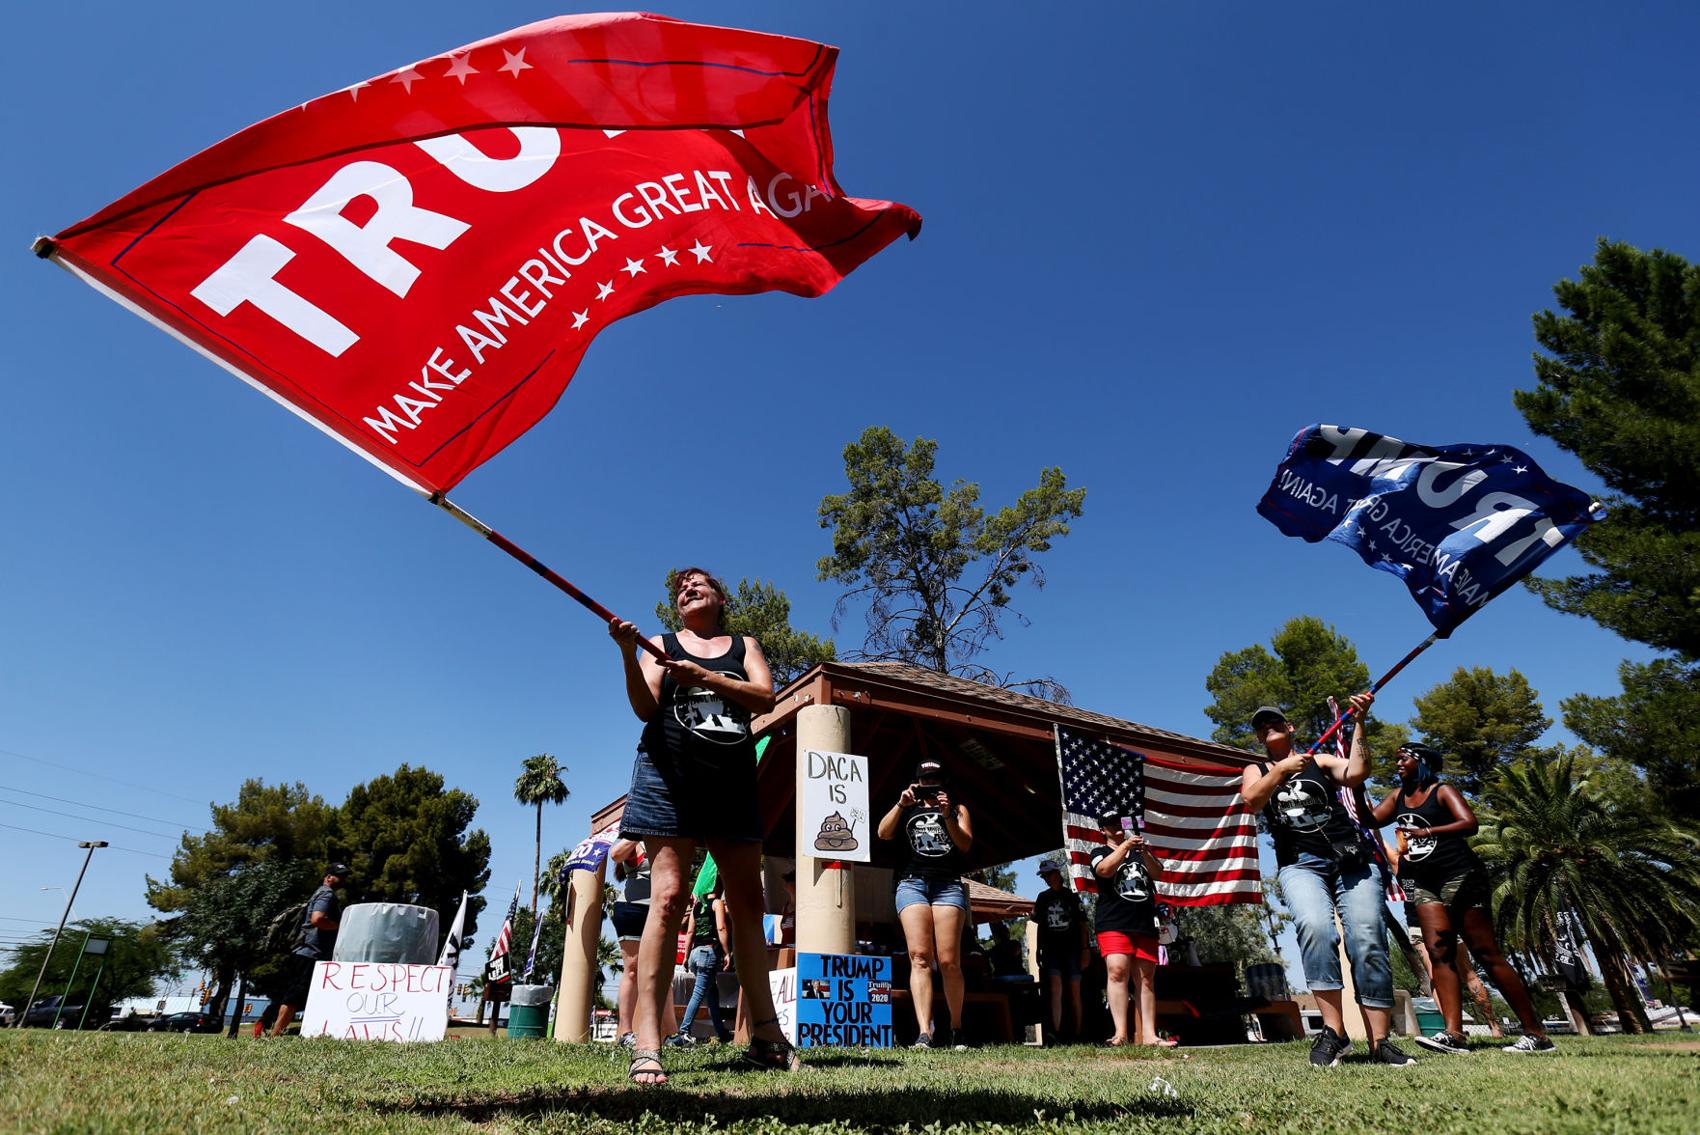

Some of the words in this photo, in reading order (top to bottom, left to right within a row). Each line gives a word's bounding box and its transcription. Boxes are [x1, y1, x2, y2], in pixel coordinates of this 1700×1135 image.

[190, 125, 745, 358] TRU
[362, 346, 472, 445] MAKE
[455, 216, 619, 365] AMERICA
[611, 169, 740, 229] GREAT
[807, 751, 863, 782] DACA
[829, 784, 847, 804] IS
[320, 961, 451, 993] RESPECT
[820, 955, 884, 980] TRUMP
[838, 979, 855, 1001] IS
[346, 991, 406, 1016] OUR
[821, 1001, 873, 1024] YOUR
[797, 1023, 893, 1048] PRESIDENT
